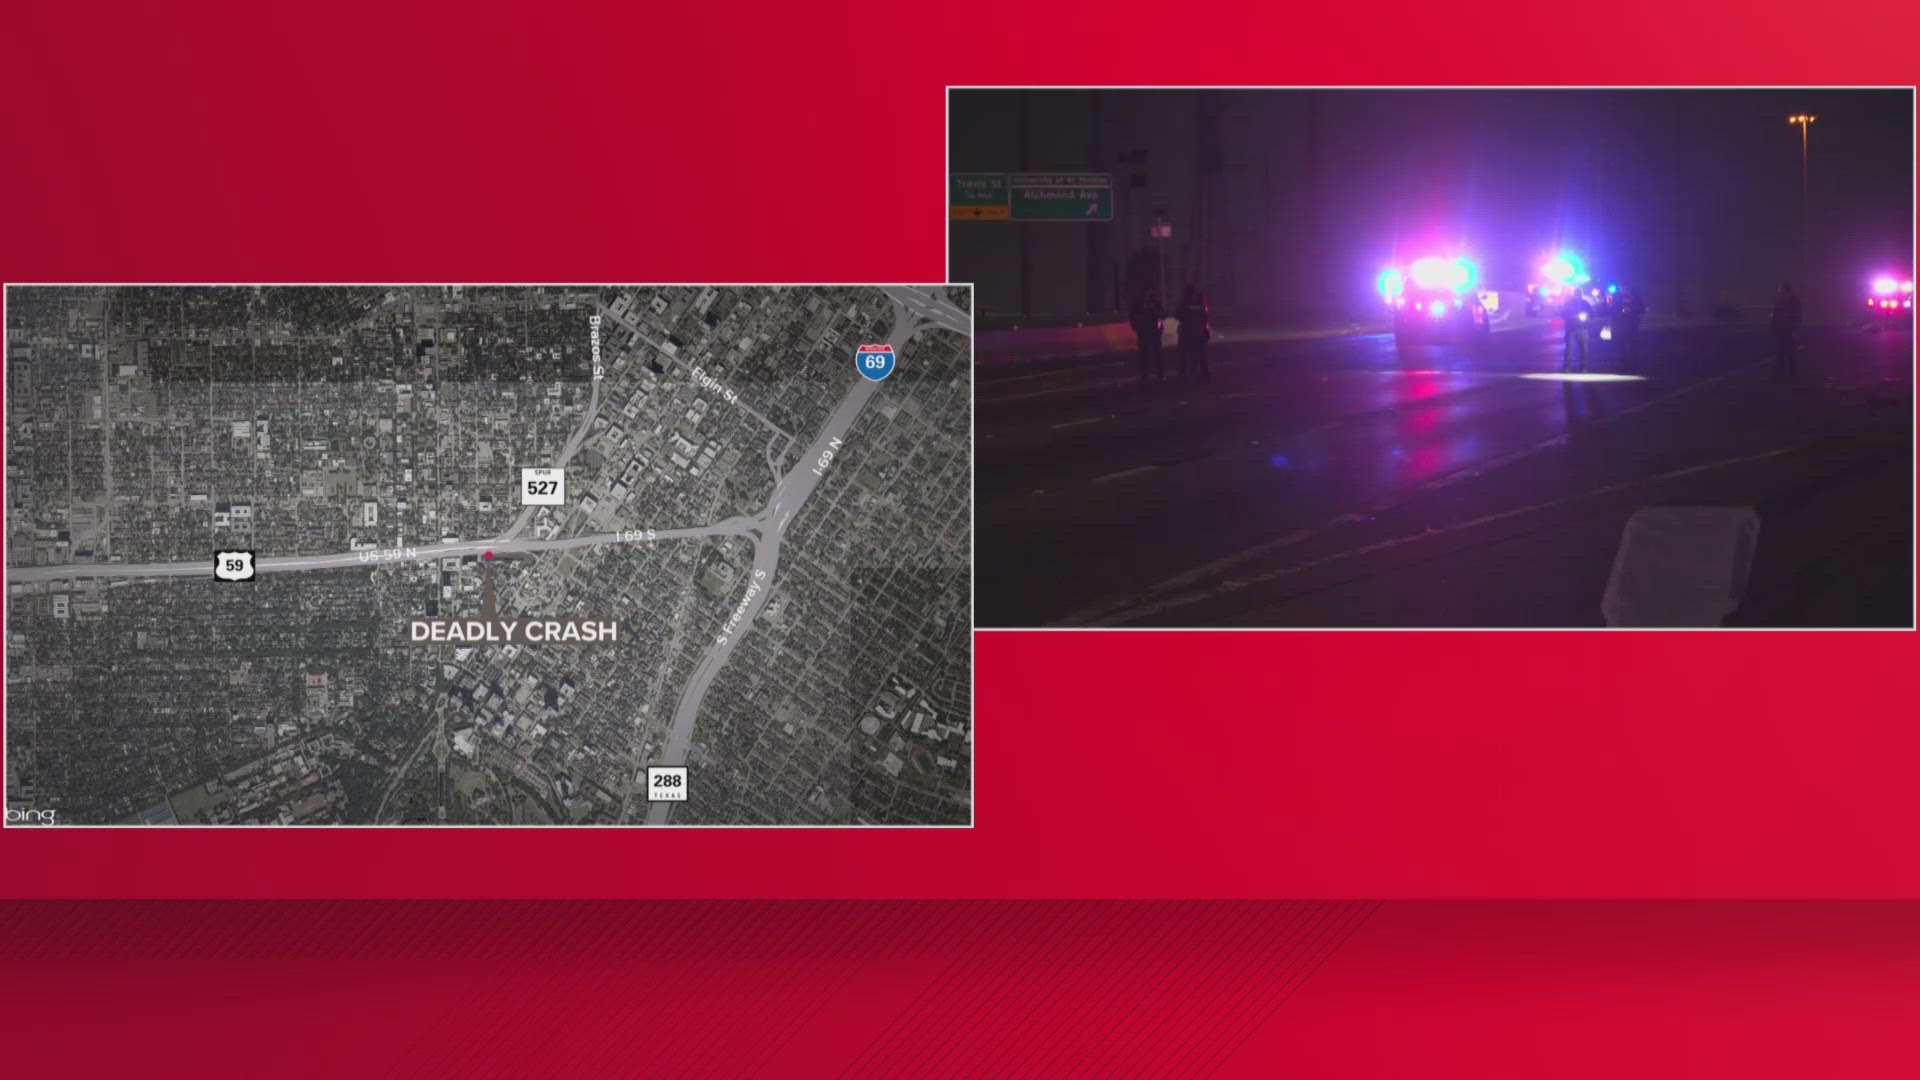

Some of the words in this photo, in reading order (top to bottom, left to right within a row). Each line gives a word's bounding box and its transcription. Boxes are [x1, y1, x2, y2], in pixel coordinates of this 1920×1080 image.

[957, 179, 988, 189] Travis
[991, 179, 1002, 189] St
[1024, 190, 1075, 200] Richmond
[1080, 190, 1098, 200] Ave
